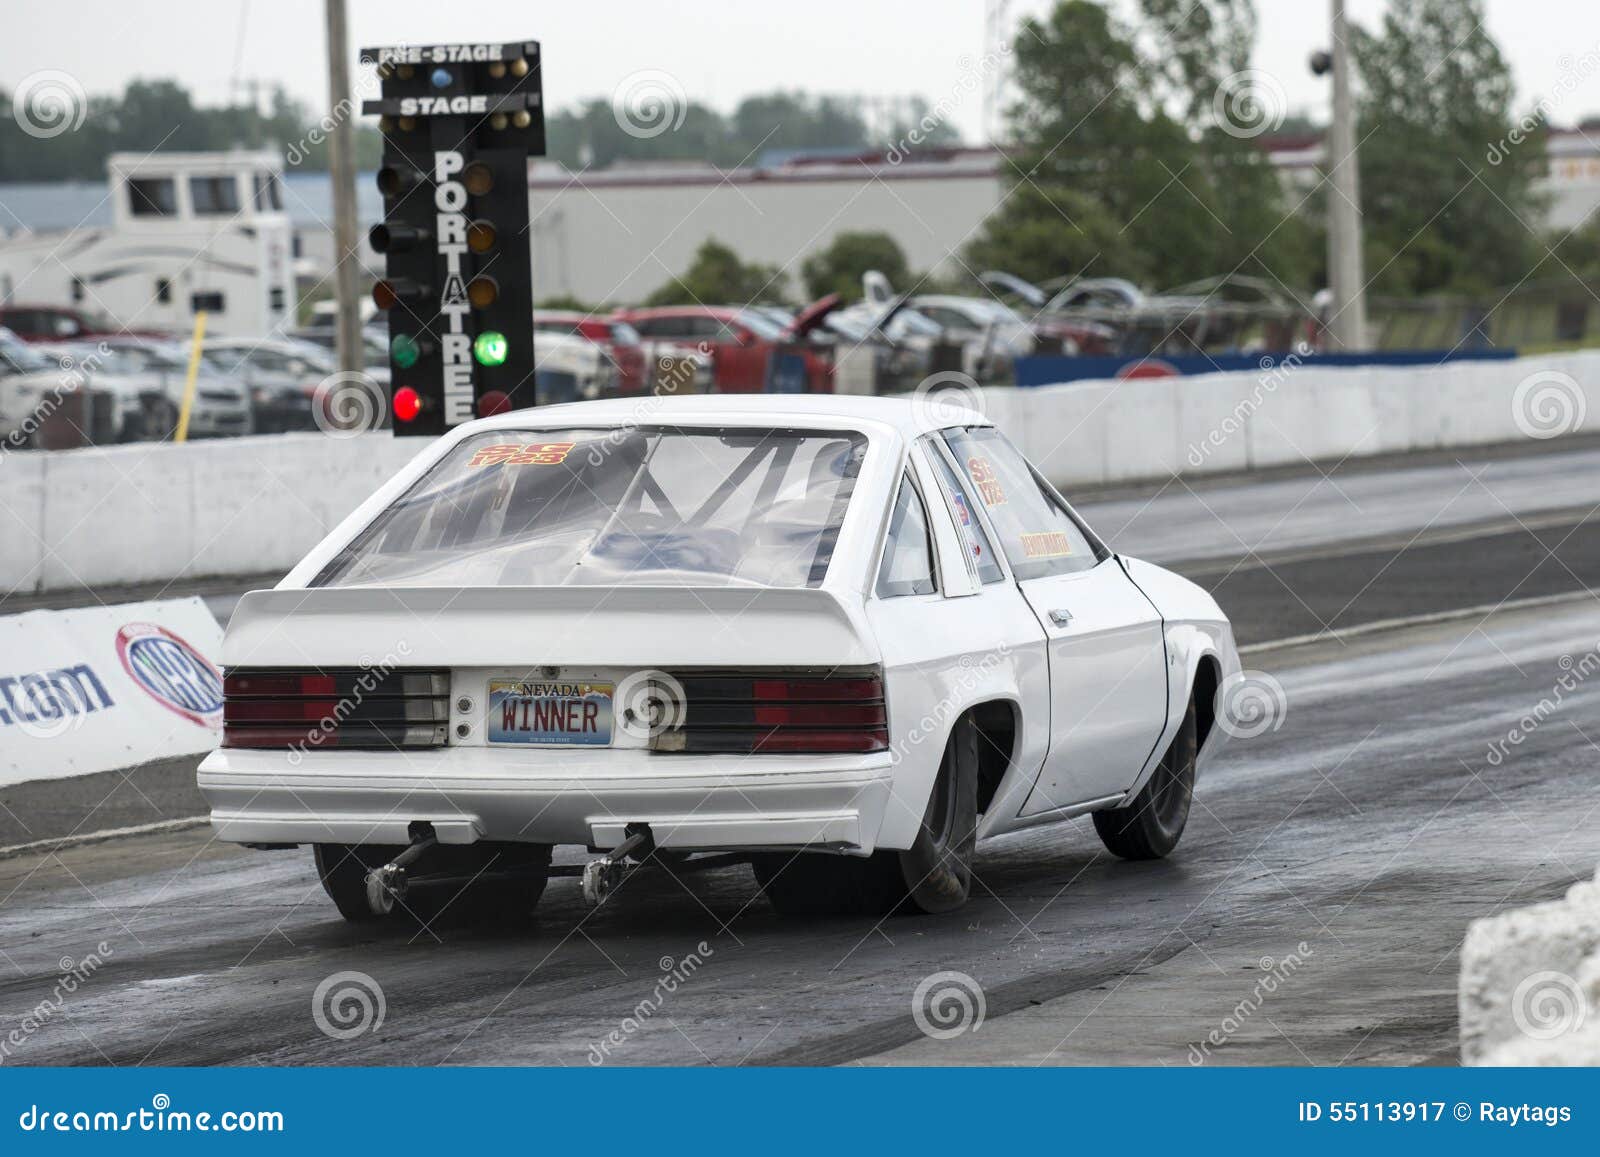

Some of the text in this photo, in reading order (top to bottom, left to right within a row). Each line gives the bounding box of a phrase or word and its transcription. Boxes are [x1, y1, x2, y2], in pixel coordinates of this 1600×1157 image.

[379, 44, 502, 64] PRE-STAGE
[400, 96, 488, 115] STAGE
[434, 151, 475, 425] PORTATREE
[522, 683, 581, 697] NEVADA
[502, 699, 599, 733] WINNER
